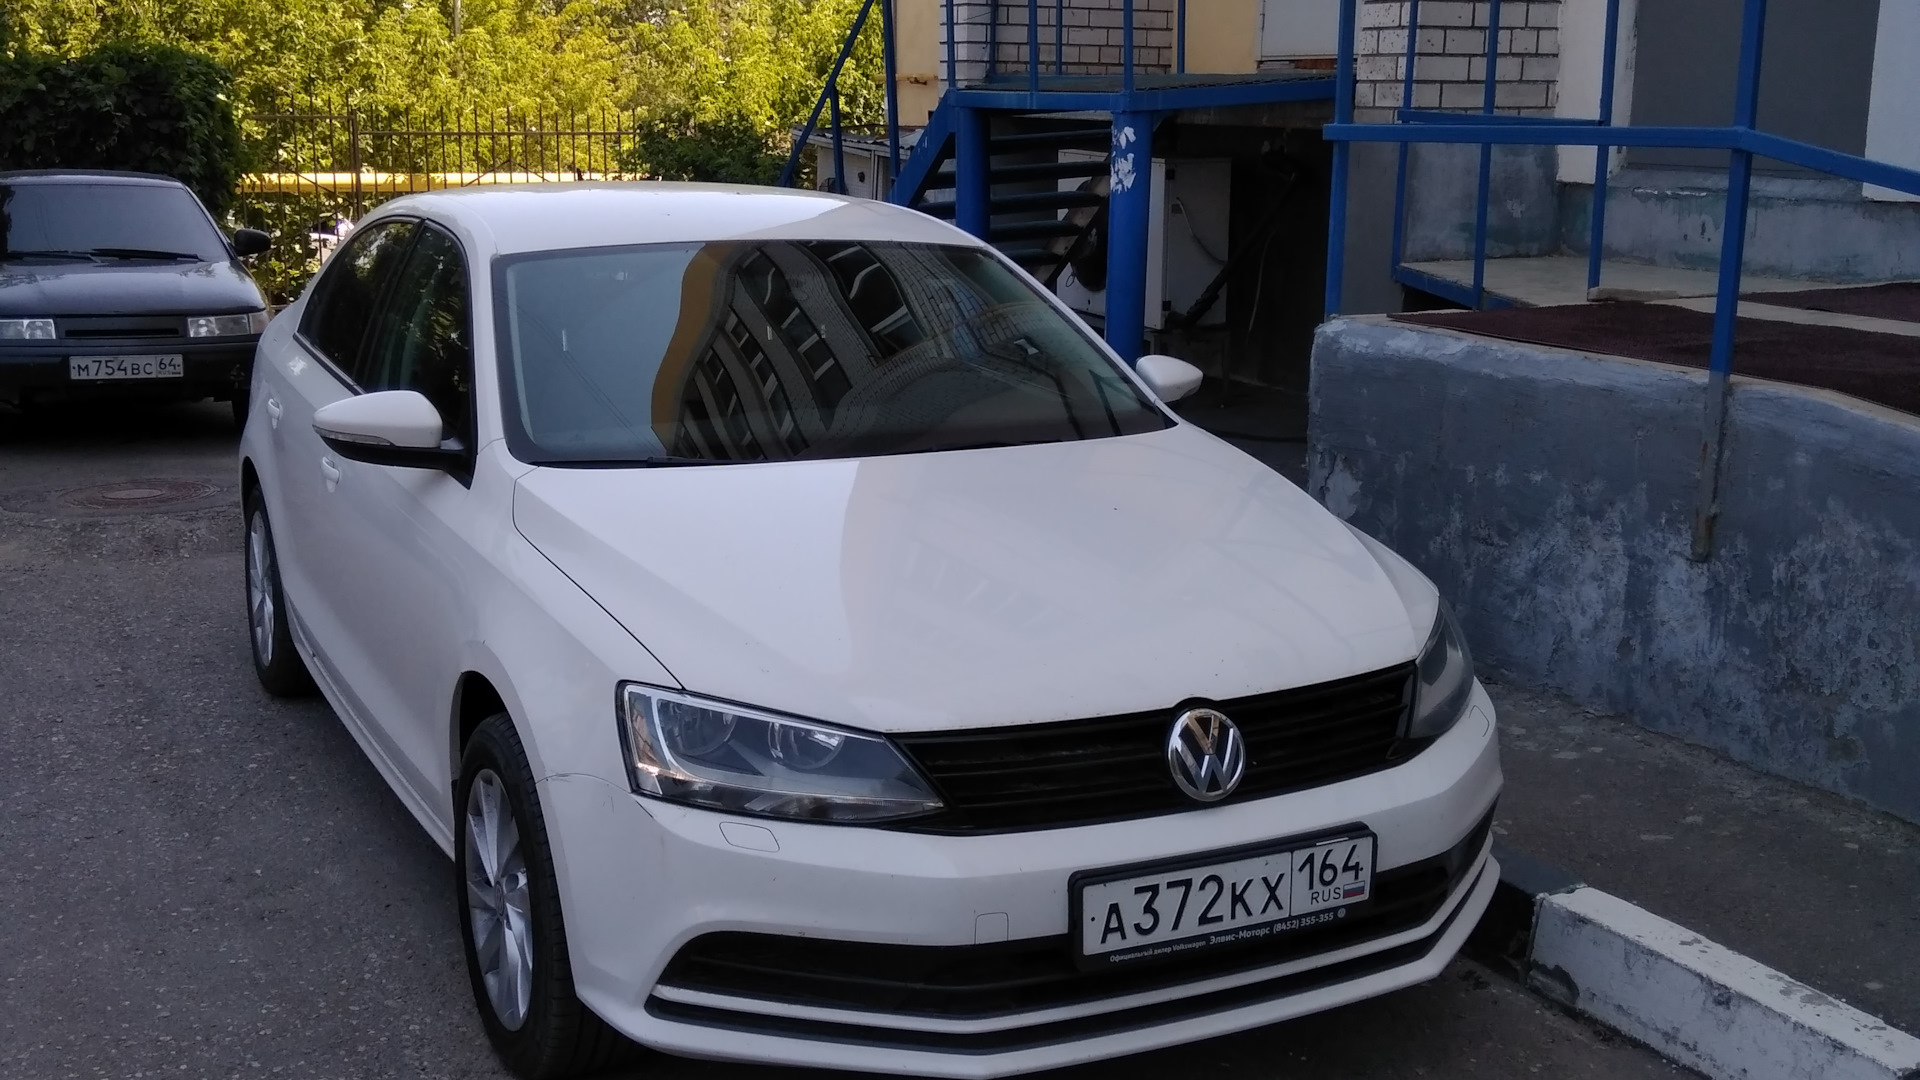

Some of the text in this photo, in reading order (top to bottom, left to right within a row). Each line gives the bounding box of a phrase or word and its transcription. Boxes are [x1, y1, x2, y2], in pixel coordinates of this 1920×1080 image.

[77, 357, 176, 376] М754ВС 64
[1101, 844, 1360, 944] А372КХ 164
[1310, 886, 1341, 905] RUS
[1172, 940, 1207, 952] Volkswagen
[1209, 926, 1271, 945] Элвис-Моторс
[1273, 919, 1300, 934] (8452)
[1300, 911, 1335, 927] 355-355
